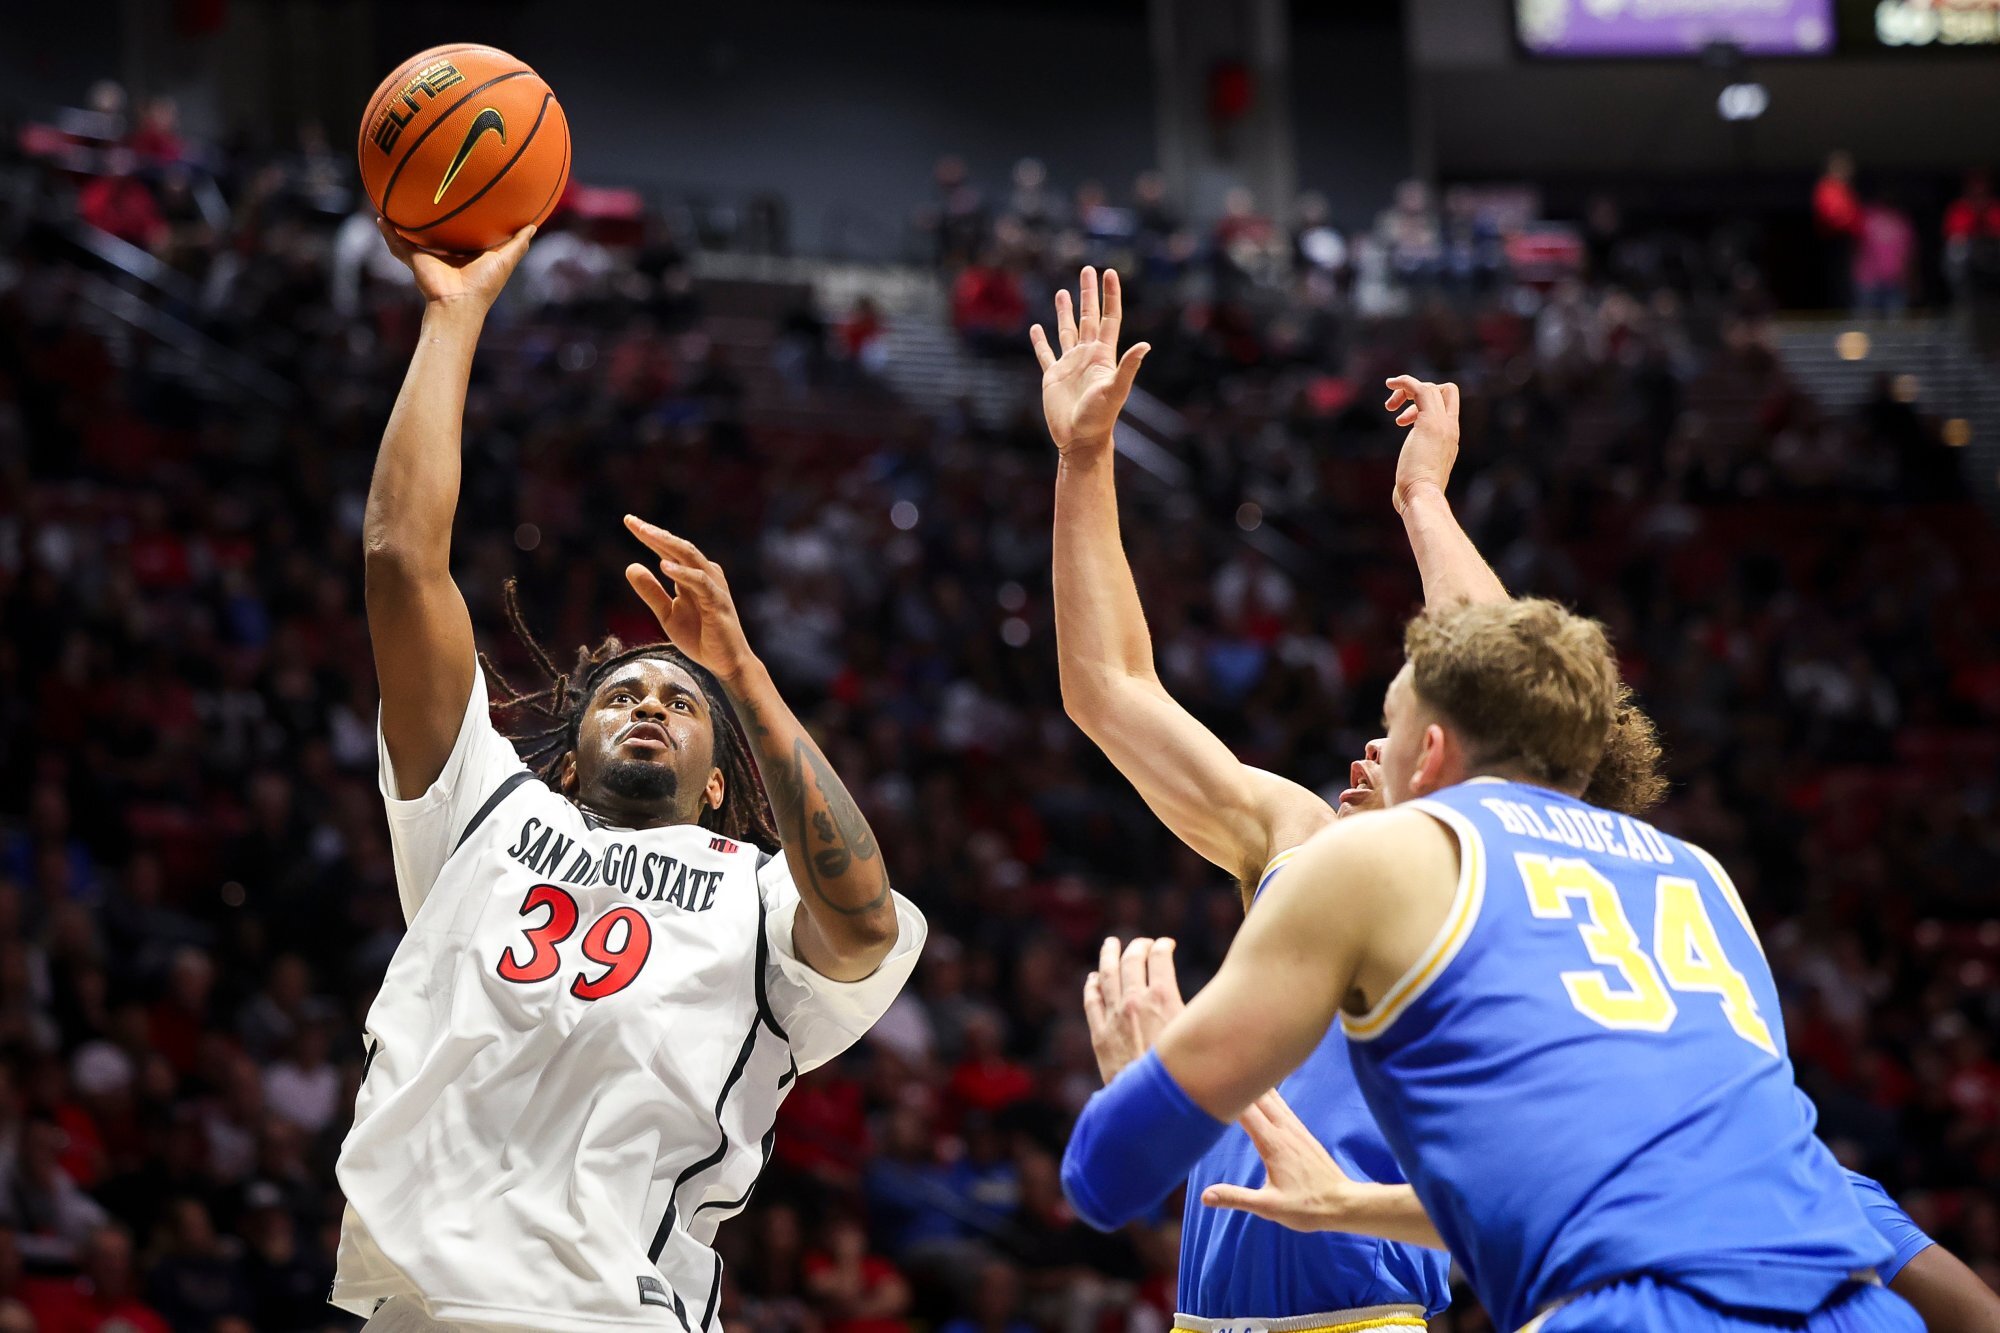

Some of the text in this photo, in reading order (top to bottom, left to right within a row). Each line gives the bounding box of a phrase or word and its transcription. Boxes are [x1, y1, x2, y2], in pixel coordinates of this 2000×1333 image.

[372, 64, 466, 157] ELITE
[507, 817, 576, 880] SAN
[635, 851, 725, 913] STATE
[1480, 797, 1675, 865] BILODEAU
[496, 883, 652, 1002] 39
[1513, 851, 1781, 1059] 34
